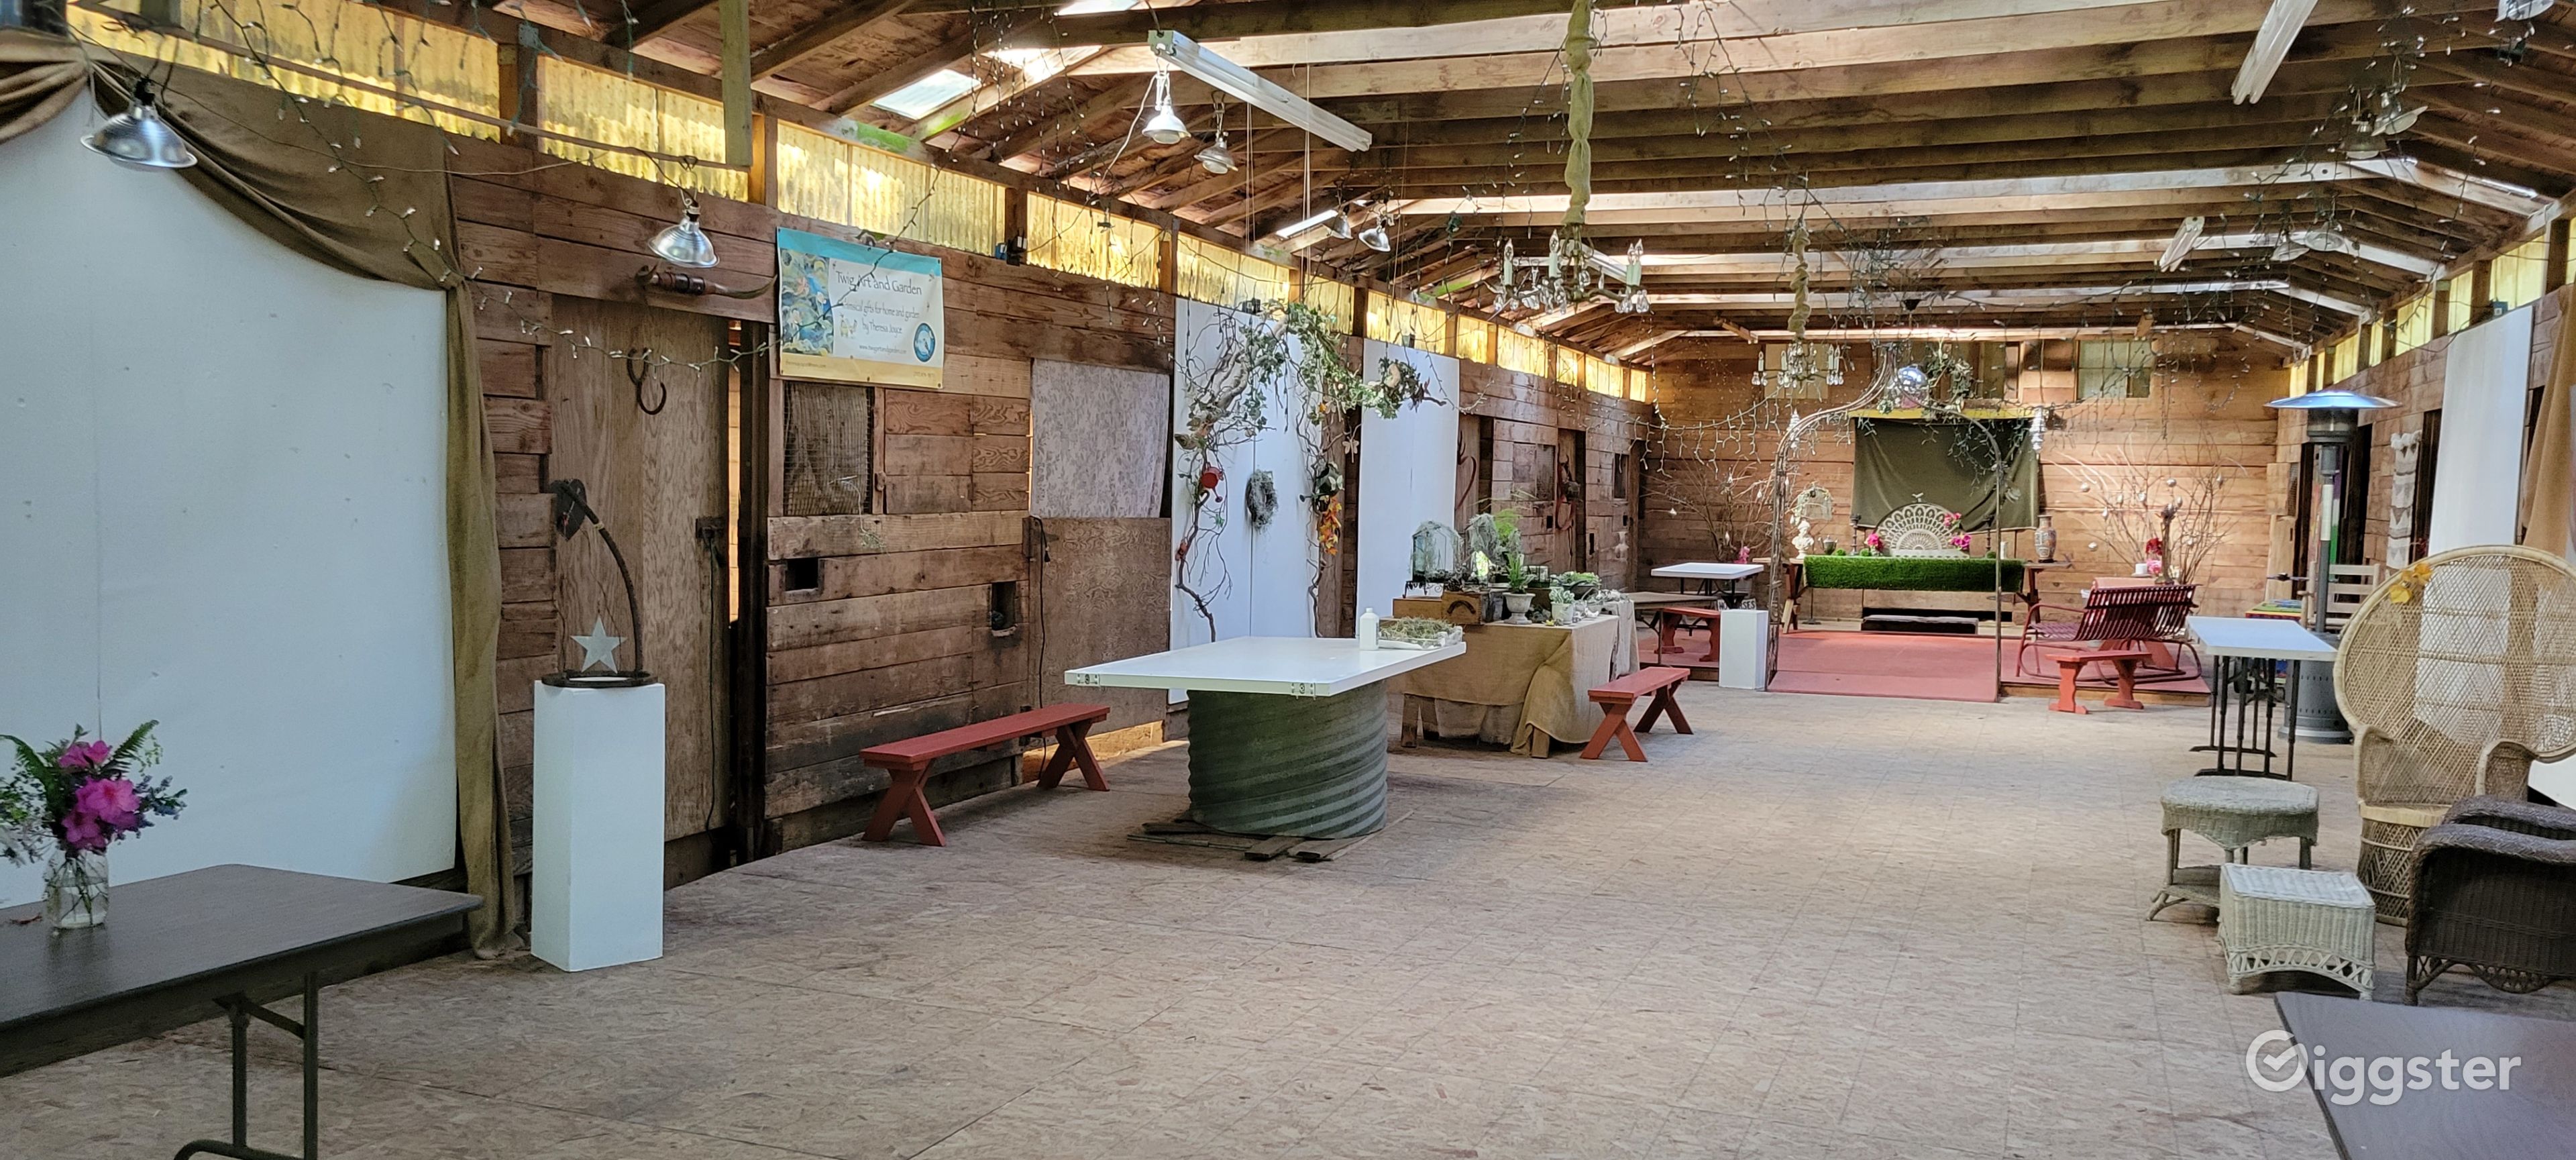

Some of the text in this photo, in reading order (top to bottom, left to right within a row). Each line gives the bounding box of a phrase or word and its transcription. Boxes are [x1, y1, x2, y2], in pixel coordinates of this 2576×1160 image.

[835, 270, 922, 295] Twig Art and Garden
[882, 301, 895, 316] home
[896, 305, 904, 317] and
[862, 317, 902, 338] by Theresa Joyce
